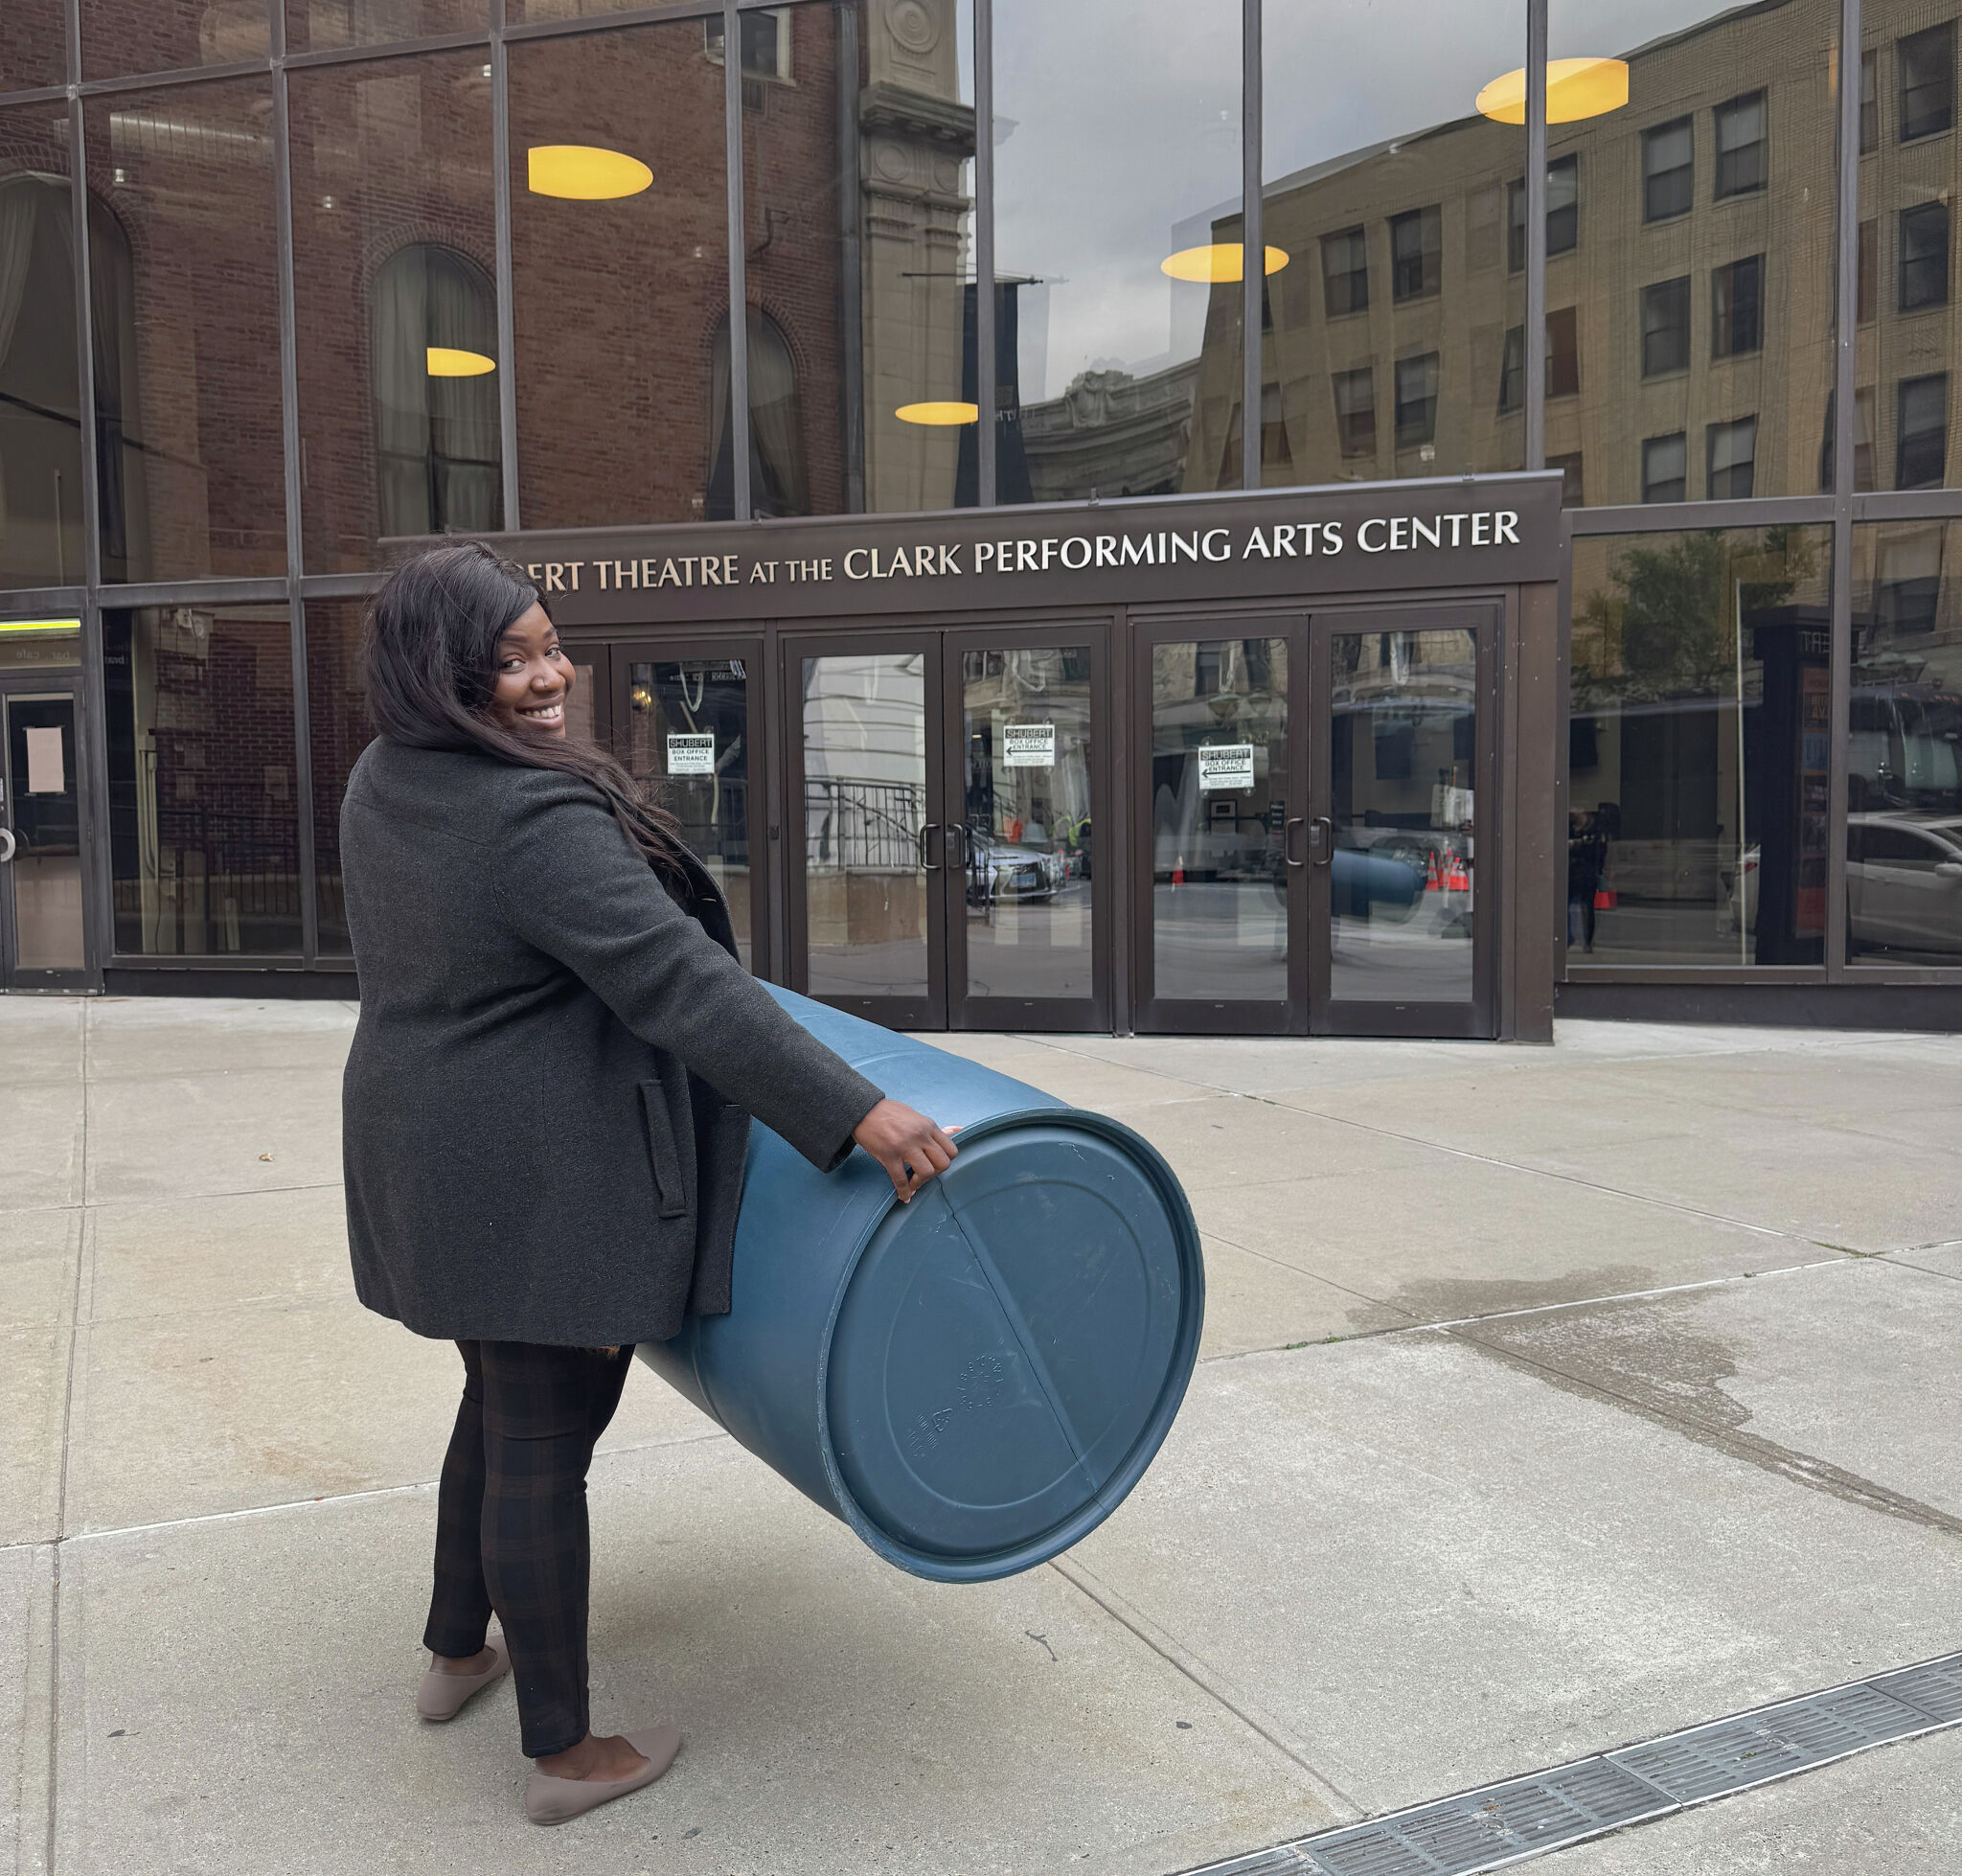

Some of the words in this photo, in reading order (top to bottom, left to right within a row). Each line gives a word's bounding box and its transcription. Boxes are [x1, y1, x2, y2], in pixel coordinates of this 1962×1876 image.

[592, 555, 741, 590] THEATRE
[749, 561, 780, 584] AT
[785, 559, 833, 583] THE
[843, 543, 963, 581] CLARK
[974, 528, 1232, 575] PERFORMING
[1242, 521, 1343, 561] ARTS
[1357, 511, 1521, 554] CENTER
[1006, 728, 1052, 739] SHUBERT
[670, 738, 712, 747] SHUBERT
[1201, 749, 1249, 760] SHUBERT
